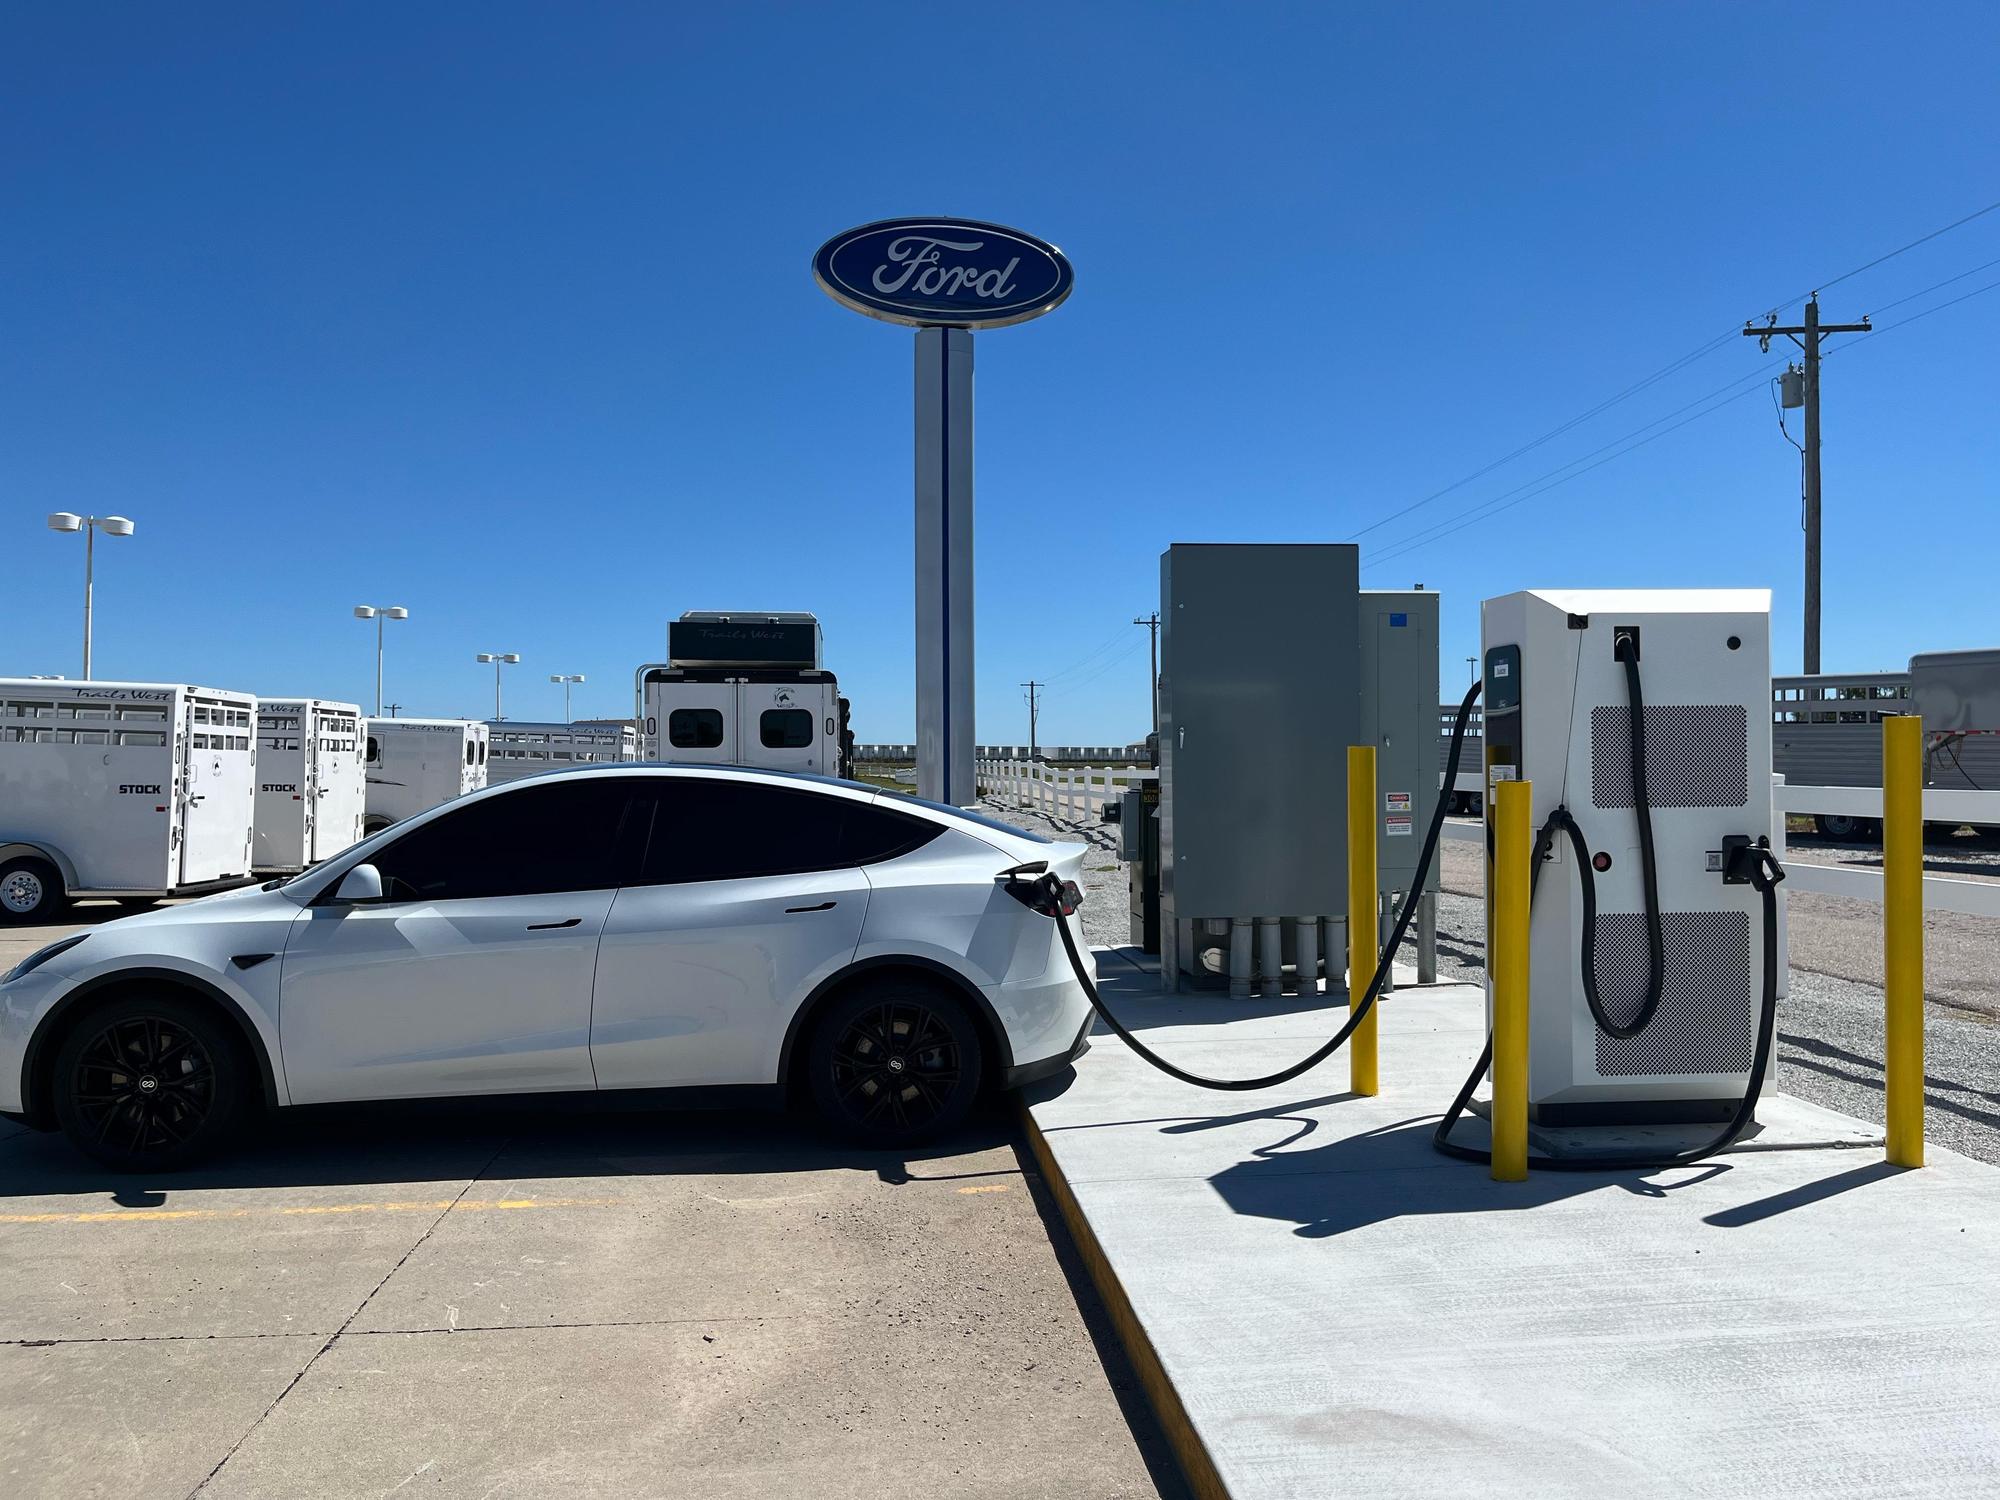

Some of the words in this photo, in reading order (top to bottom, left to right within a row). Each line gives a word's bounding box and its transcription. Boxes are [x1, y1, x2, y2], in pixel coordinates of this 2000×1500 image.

[872, 236, 1020, 298] Ford
[698, 629, 746, 639] Trails
[750, 629, 785, 639] West
[72, 688, 126, 699] Trails
[131, 690, 170, 701] West
[270, 704, 302, 713] West
[119, 785, 161, 794] STOCK
[262, 784, 296, 792] STOCK
